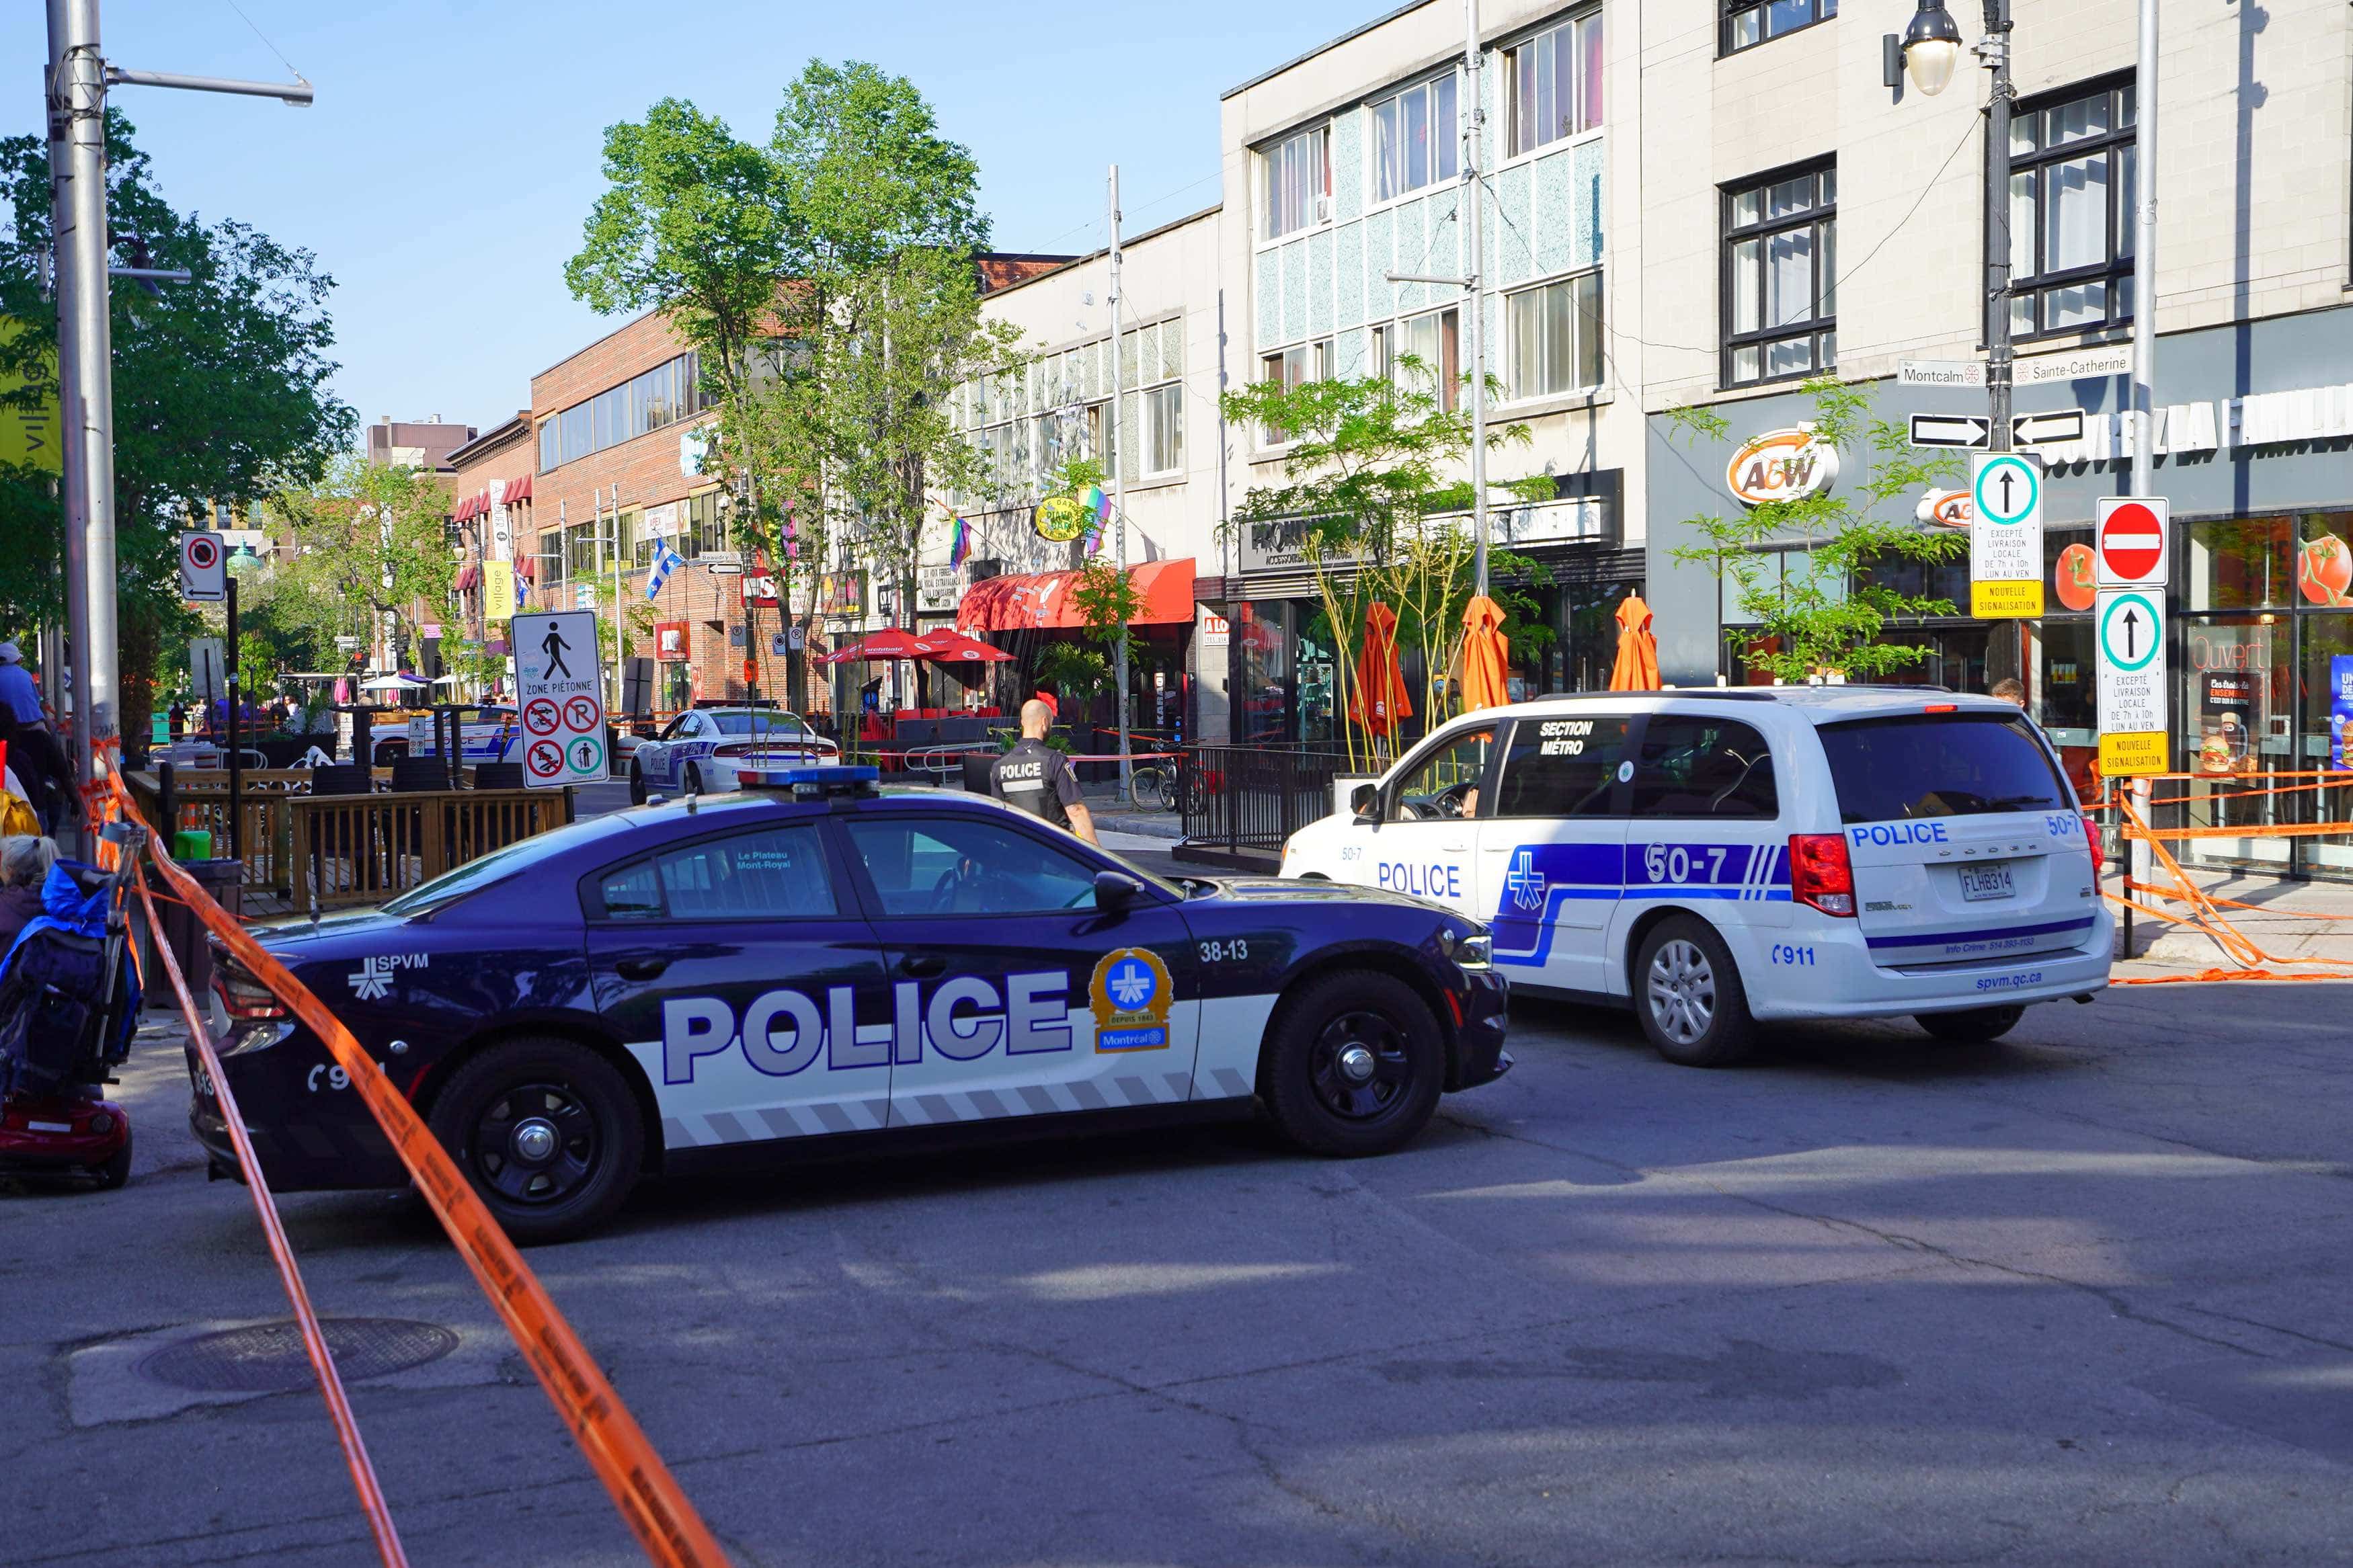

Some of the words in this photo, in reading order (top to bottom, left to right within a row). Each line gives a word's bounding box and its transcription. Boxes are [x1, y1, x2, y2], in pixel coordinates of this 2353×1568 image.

[1904, 368, 1963, 382] Montcalm
[2033, 357, 2126, 379] Sainte-Catherine
[1741, 452, 1817, 493] A&W
[1944, 503, 1971, 520] A&
[1991, 528, 2023, 538] EXCEPTÉ
[1988, 540, 2026, 548] LIVRAISON
[1993, 550, 2021, 558] LOCALE
[1985, 560, 1993, 569] DE
[1985, 570, 1999, 578] LUN
[2003, 570, 2012, 578] AU
[2016, 569, 2030, 577] VEN
[493, 570, 504, 610] village
[1989, 587, 2026, 597] NOUVELLE
[1979, 602, 2036, 611] SIGNALISATION
[2192, 636, 2265, 669] Ouvert
[2116, 674, 2147, 686] EXCEPTÉ
[527, 684, 549, 695] ZONE
[553, 680, 592, 693] PIÉTONNE
[2114, 688, 2151, 697] LIVRAISON
[2210, 688, 2249, 698] ENSEMBLE
[2119, 699, 2145, 708] LOCALE
[2111, 712, 2120, 720] DE
[2124, 711, 2131, 719] 7h
[2143, 710, 2153, 718] 10h
[1540, 721, 1593, 736] SECTION
[2111, 723, 2125, 732] LUN
[2128, 723, 2138, 731] AU
[2141, 721, 2155, 730] VEN
[1540, 737, 1584, 755] MÉTRO
[2116, 740, 2151, 751] NOUVELLE
[2107, 755, 2161, 768] SIGNALISATION
[1000, 761, 1041, 779] POLICE
[2046, 814, 2081, 836] 50-7
[1850, 822, 1948, 847] POLICE
[738, 852, 750, 860] Le
[752, 850, 787, 860] Plateau
[1343, 847, 1361, 860] 50-7
[737, 860, 791, 870] Mont-Royal
[1648, 845, 1727, 884] 50-7
[1379, 862, 1461, 897] POLICE
[1963, 871, 2011, 893] FLH8314
[1200, 939, 1248, 962] 38-13
[1963, 943, 1986, 953] Crime
[1989, 940, 2002, 950] 514
[377, 953, 429, 971] SPVM
[1783, 946, 1815, 966] 911
[1977, 972, 2042, 992] spvm.qc.ca
[1111, 1016, 1135, 1024] DEPUIS
[662, 970, 1072, 1085] POLICE
[1103, 1031, 1148, 1046] Montréal
